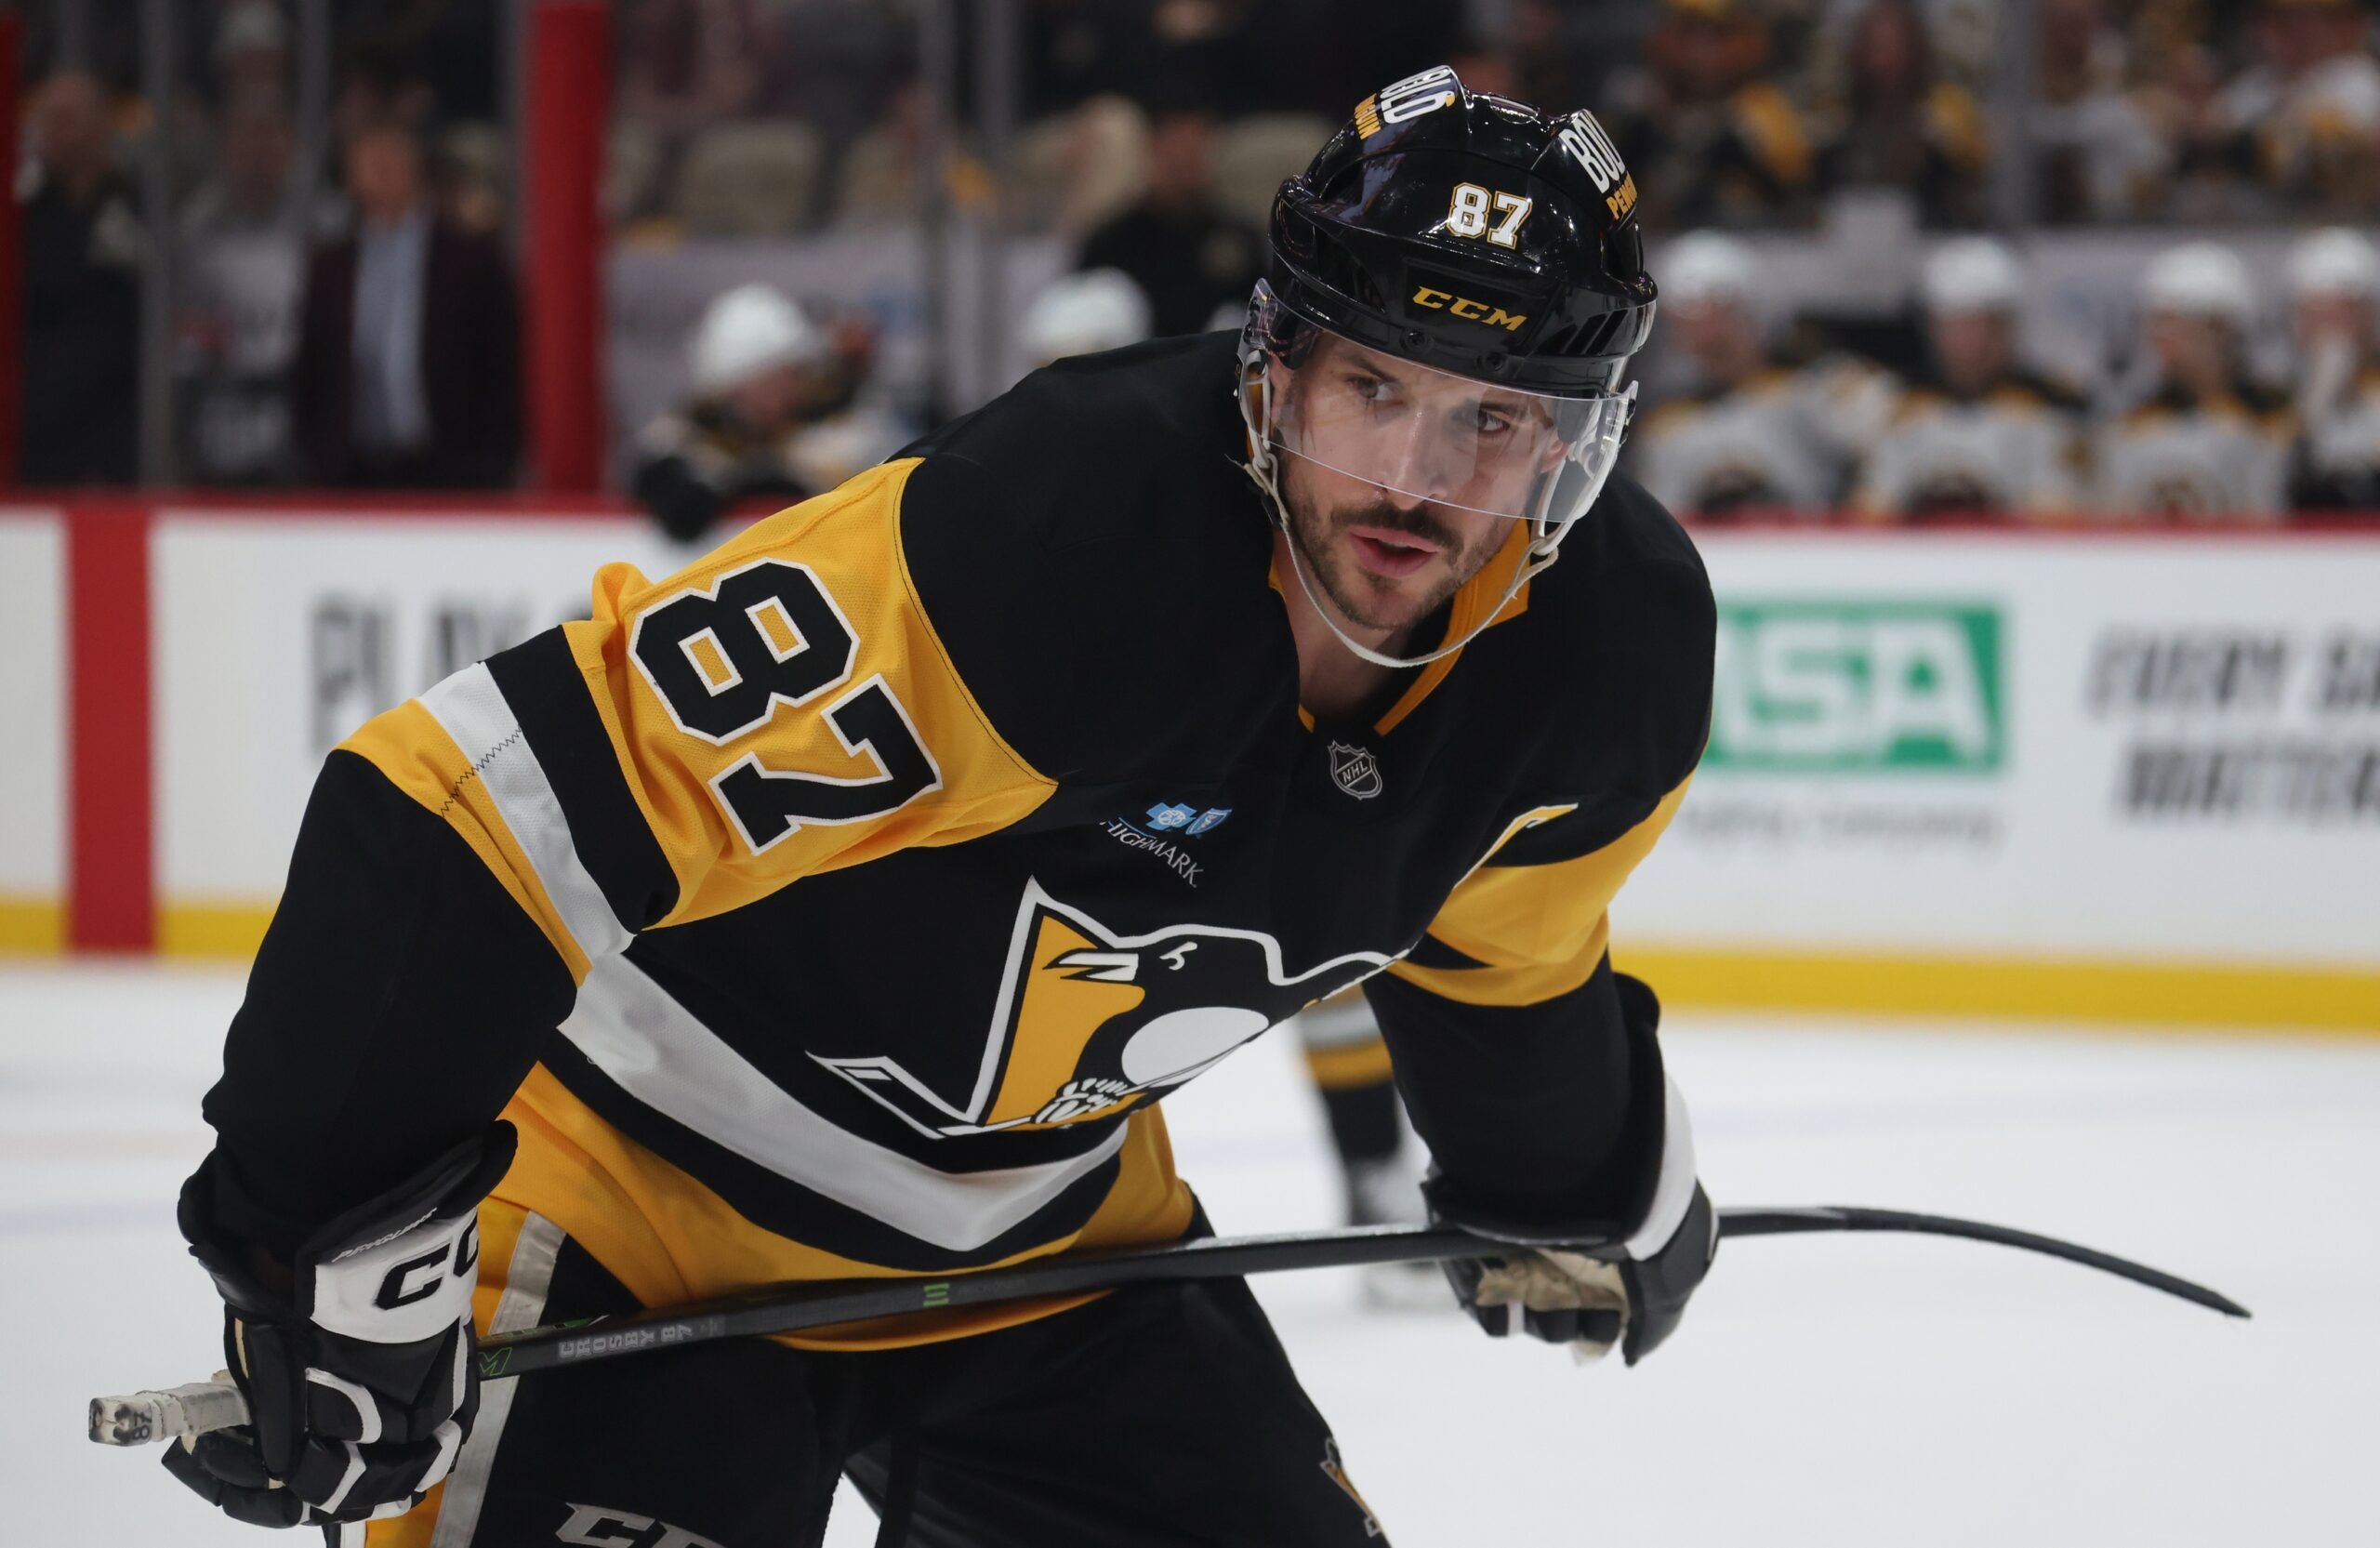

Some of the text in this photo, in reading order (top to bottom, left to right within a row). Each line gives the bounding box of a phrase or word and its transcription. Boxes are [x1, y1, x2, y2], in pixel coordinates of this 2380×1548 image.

[1380, 65, 1456, 124] OLD
[1447, 182, 1533, 250] 87
[1412, 285, 1528, 332] CCM
[628, 557, 944, 857] 87
[1713, 615, 1991, 758] SA
[1341, 761, 1368, 784] NHL
[560, 1328, 655, 1358] CROSBY
[660, 1314, 694, 1343] 87
